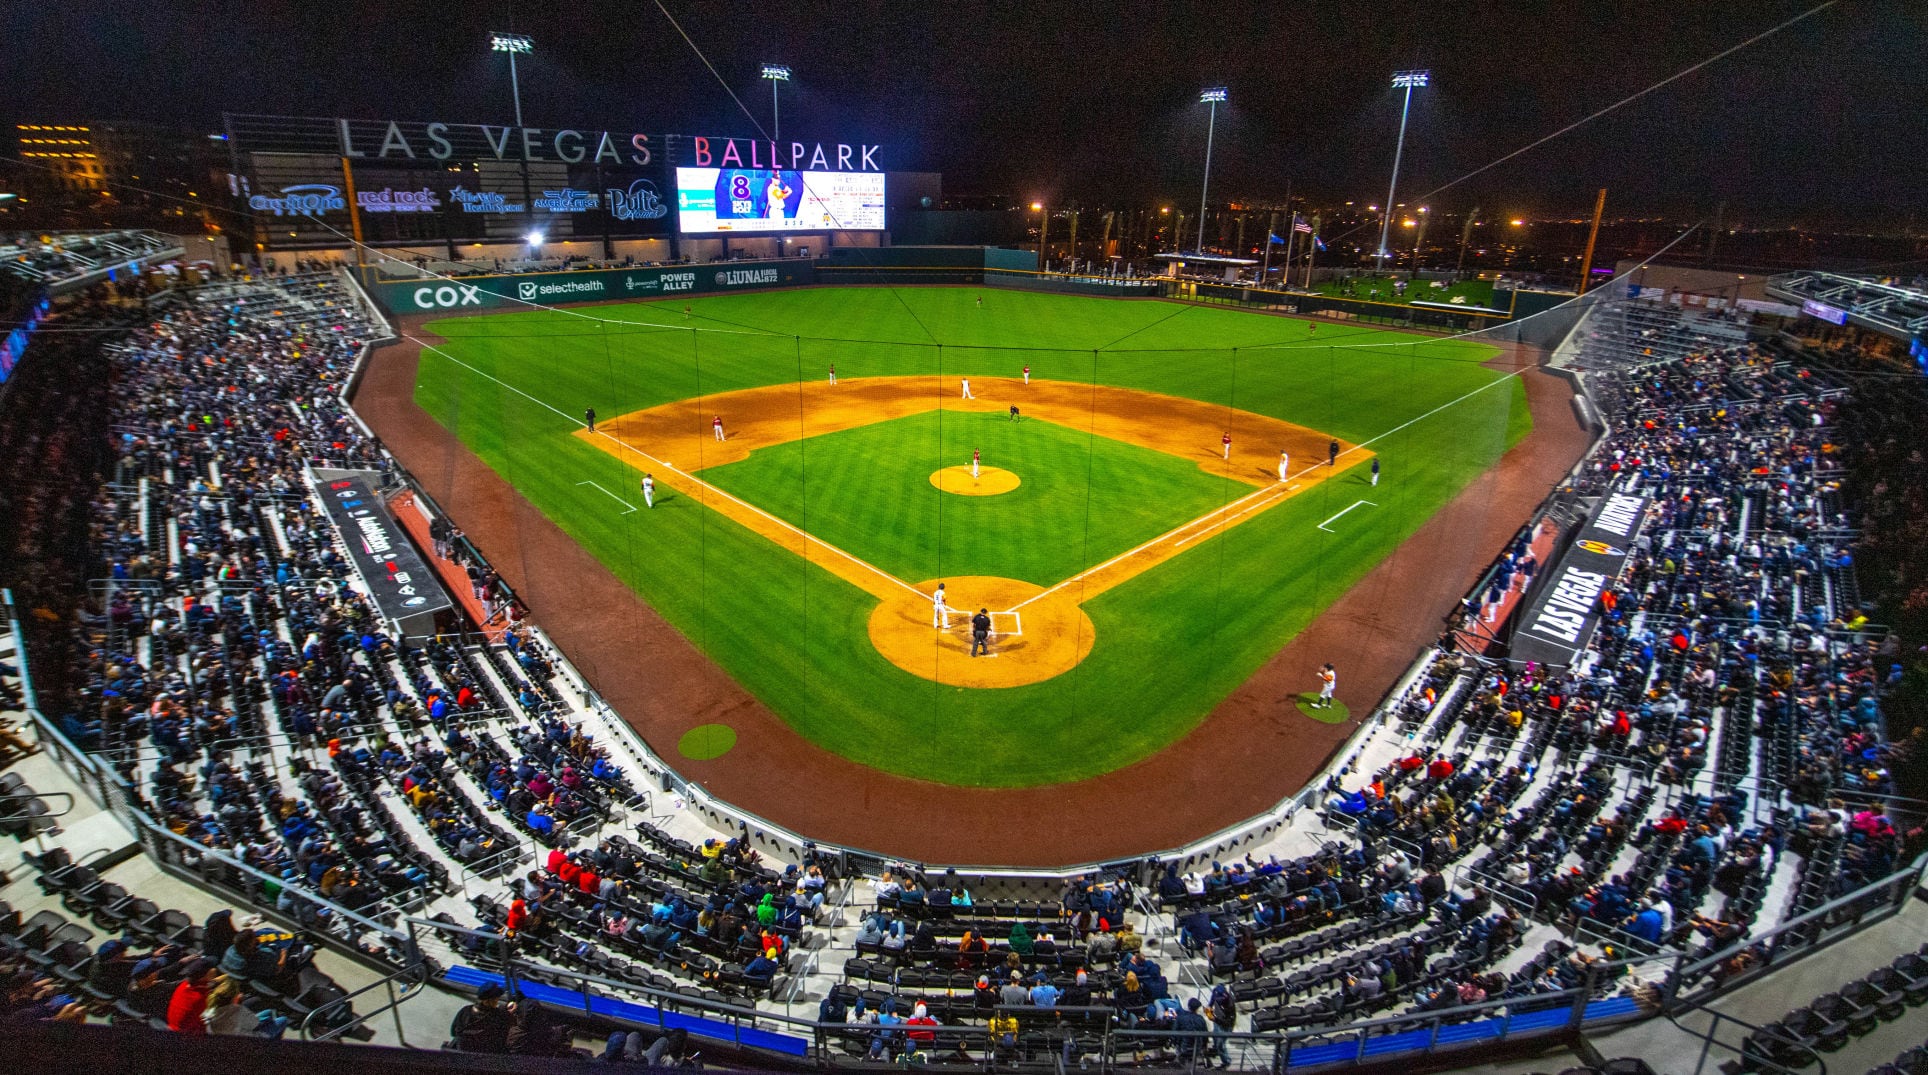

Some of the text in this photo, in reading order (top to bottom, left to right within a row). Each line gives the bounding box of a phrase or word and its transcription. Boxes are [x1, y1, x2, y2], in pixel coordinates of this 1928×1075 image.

[340, 119, 880, 171] LAS VEGAS BALLPARK
[732, 174, 752, 200] 8
[357, 187, 438, 204] red rock
[534, 199, 599, 208] AMERICA FIRST
[607, 189, 659, 217] Pulte
[660, 273, 695, 283] POWER
[726, 269, 764, 285] LiUNA!
[764, 275, 778, 283] 872
[540, 280, 603, 295] selecthealth
[663, 281, 692, 291] ALLEY
[1593, 492, 1644, 537] AVIATORS
[1532, 566, 1607, 643] LAS VEGAS
